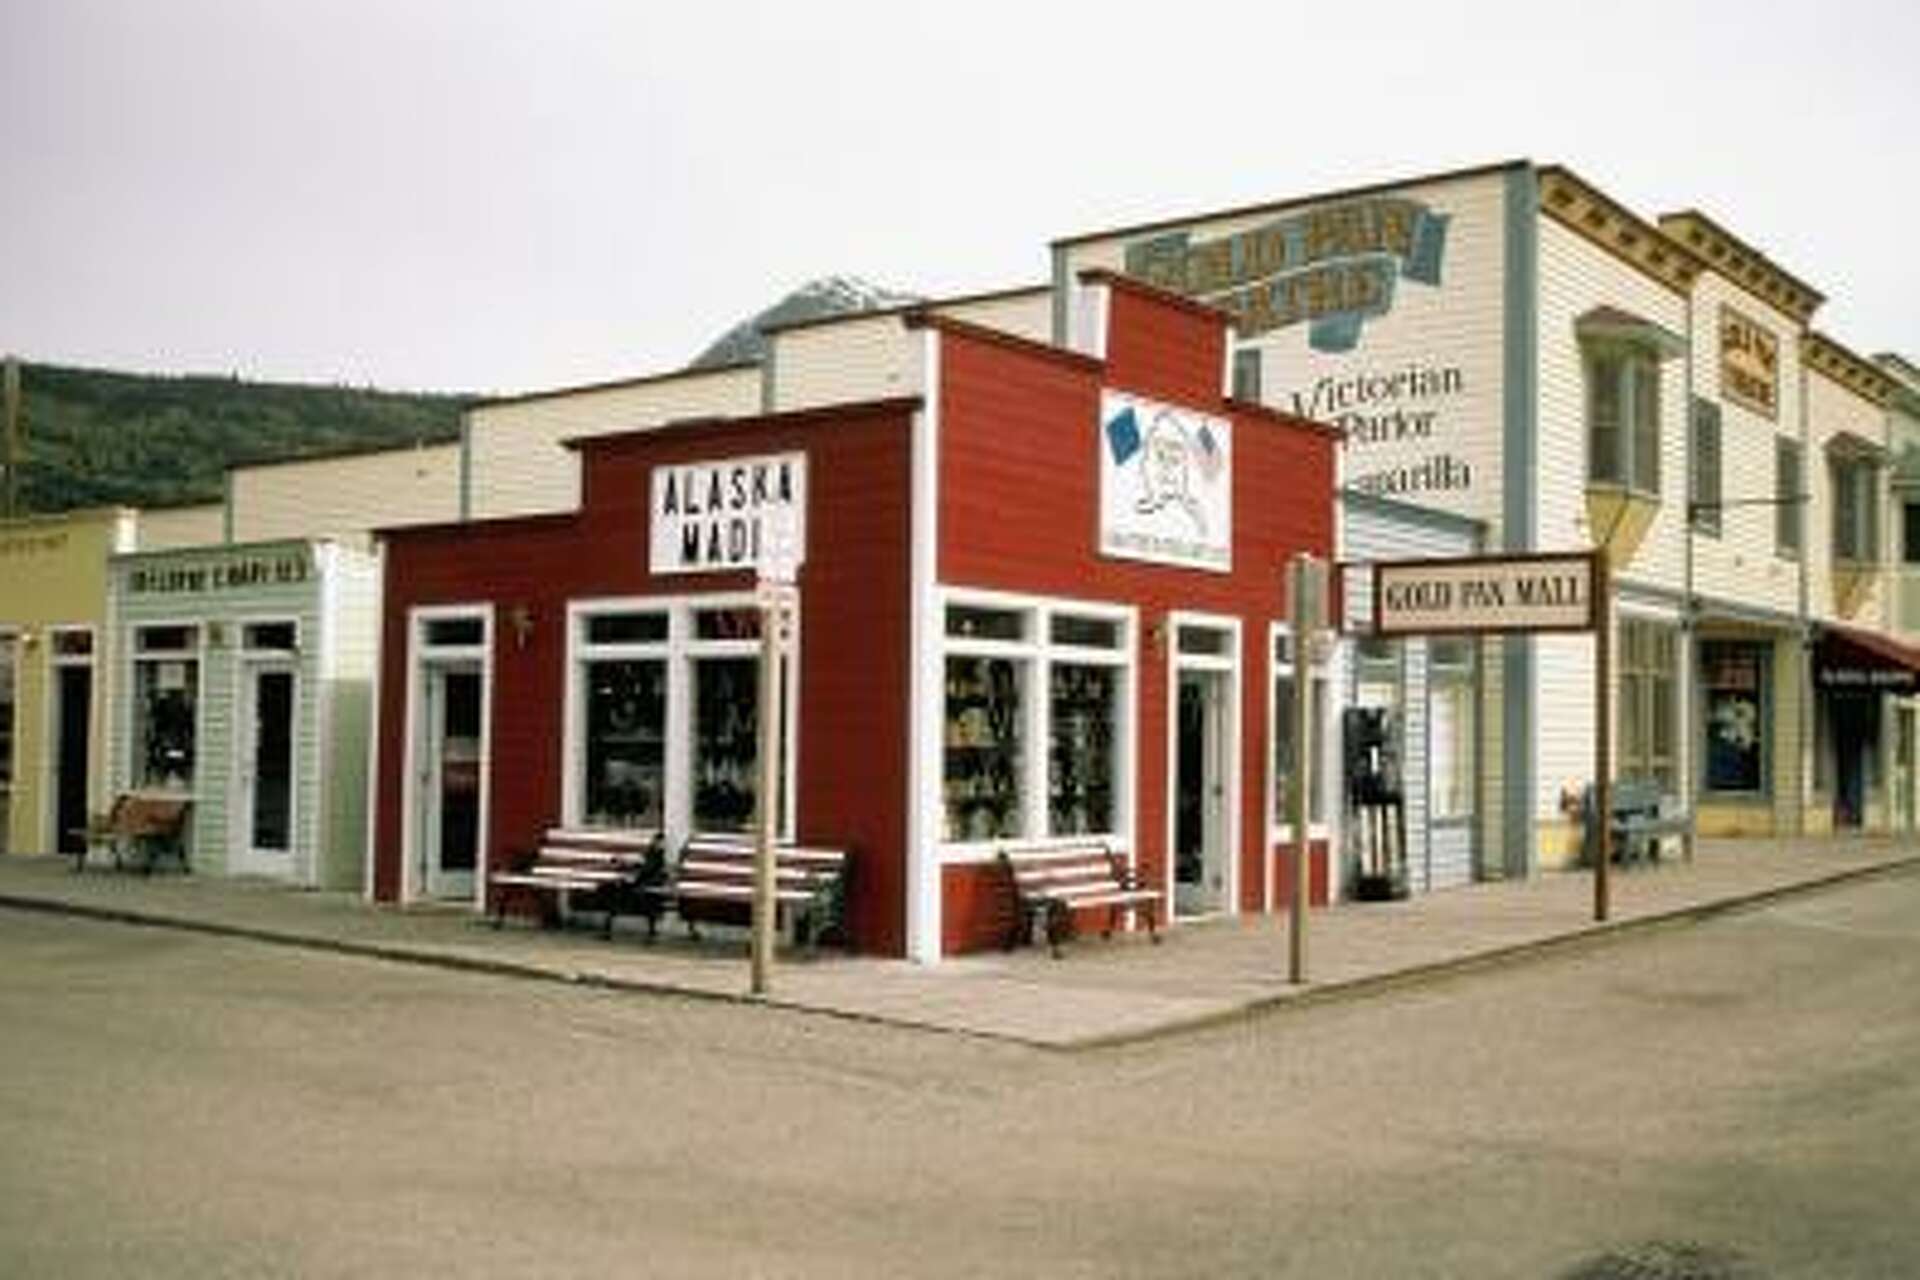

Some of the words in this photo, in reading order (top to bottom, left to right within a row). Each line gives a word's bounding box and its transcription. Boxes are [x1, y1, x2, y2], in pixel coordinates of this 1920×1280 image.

[1291, 365, 1462, 416] Victorian
[663, 463, 792, 516] ALASKA
[1386, 582, 1450, 612] GOLD
[1459, 580, 1505, 608] PAN
[1516, 575, 1578, 607] MALL
